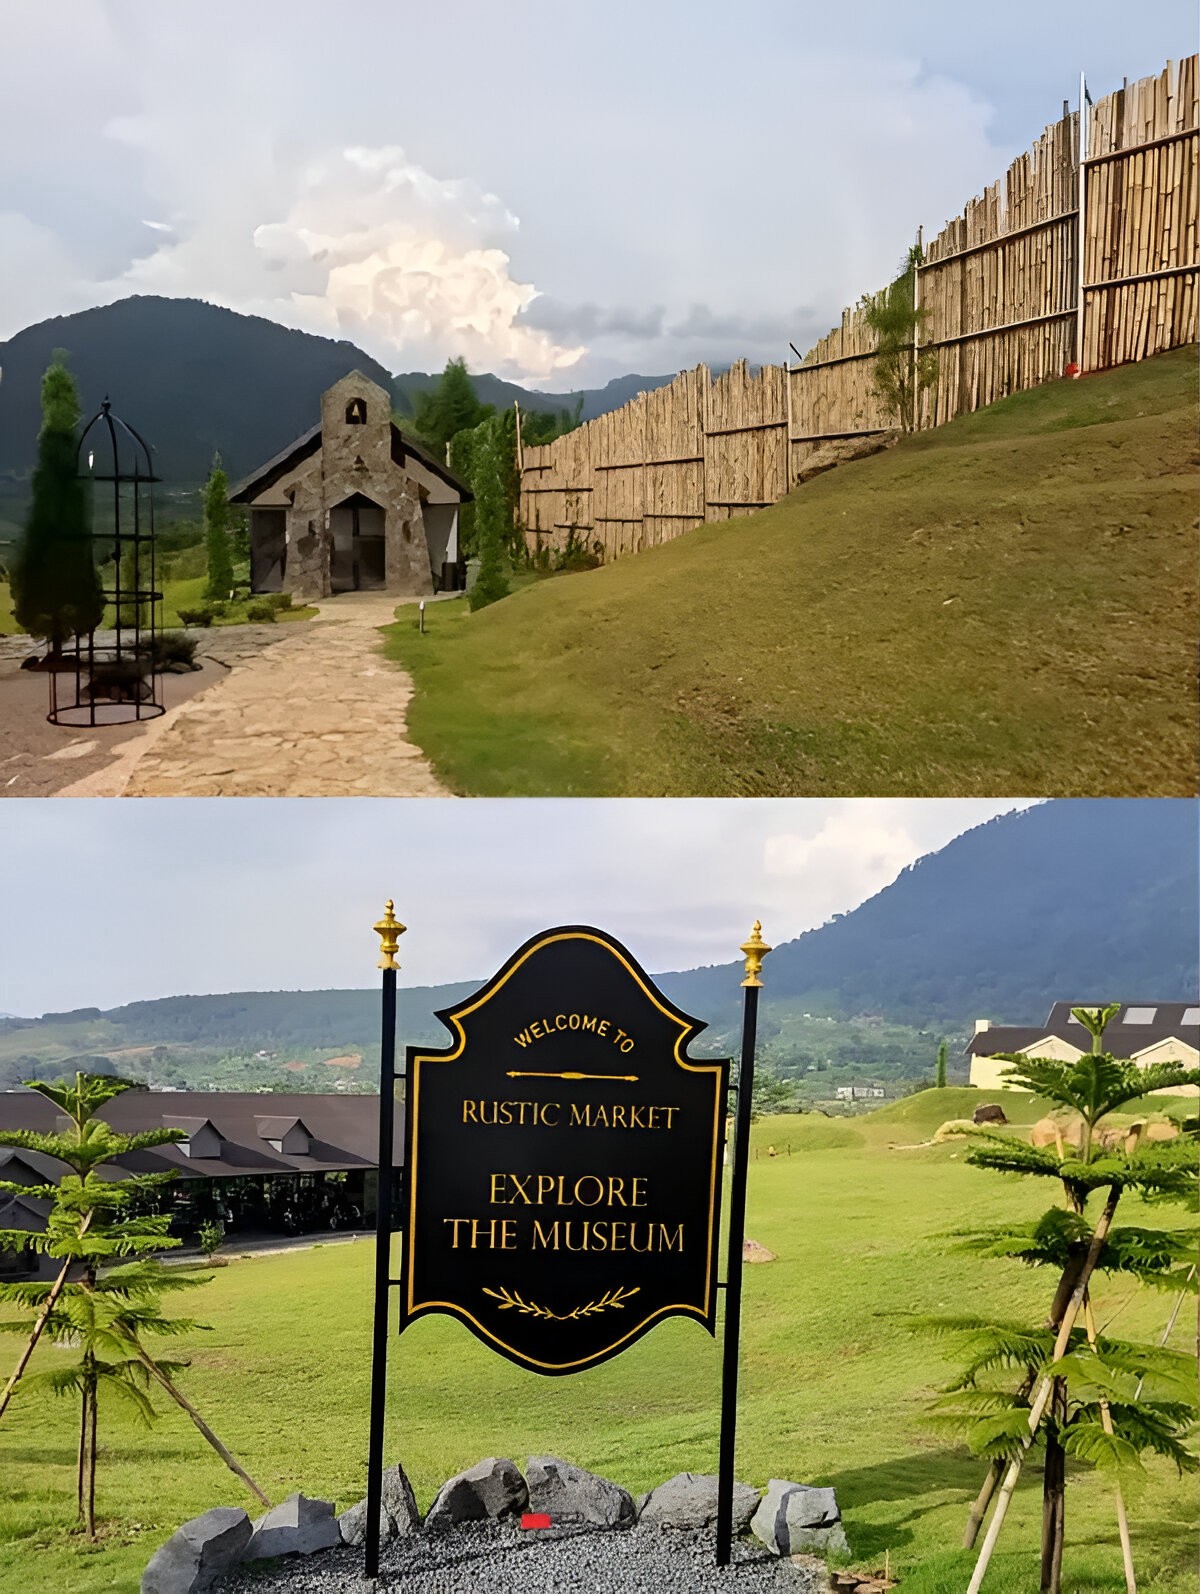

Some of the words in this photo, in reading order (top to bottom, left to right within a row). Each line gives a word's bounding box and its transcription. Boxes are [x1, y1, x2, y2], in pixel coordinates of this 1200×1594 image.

[513, 1013, 611, 1048] WELCOME
[614, 1028, 635, 1053] TO
[462, 1099, 560, 1127] RUSTIC
[569, 1102, 680, 1129] MARKET
[489, 1173, 648, 1207] EXPLORE
[443, 1218, 517, 1250] THE
[531, 1219, 684, 1253] MUSEUM
